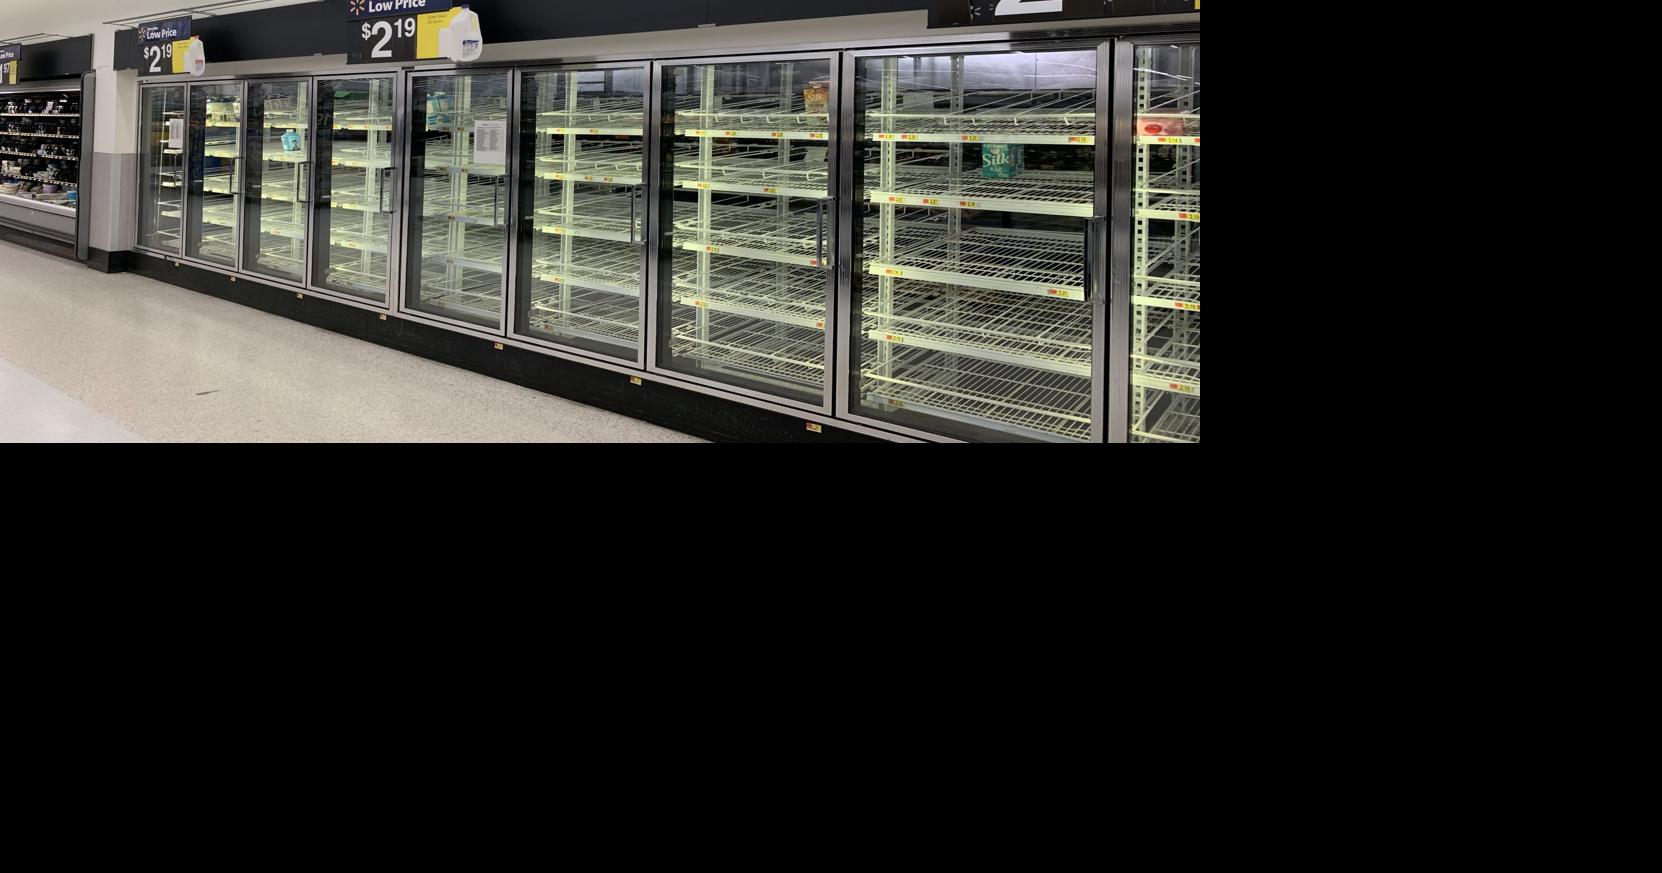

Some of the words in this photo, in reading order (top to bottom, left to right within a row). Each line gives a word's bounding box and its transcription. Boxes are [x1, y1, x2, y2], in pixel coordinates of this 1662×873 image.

[368, 1, 393, 13] Low
[395, 0, 426, 10] Price
[146, 29, 161, 40] Low
[161, 28, 177, 38] Price
[982, 152, 1010, 168] Silk
